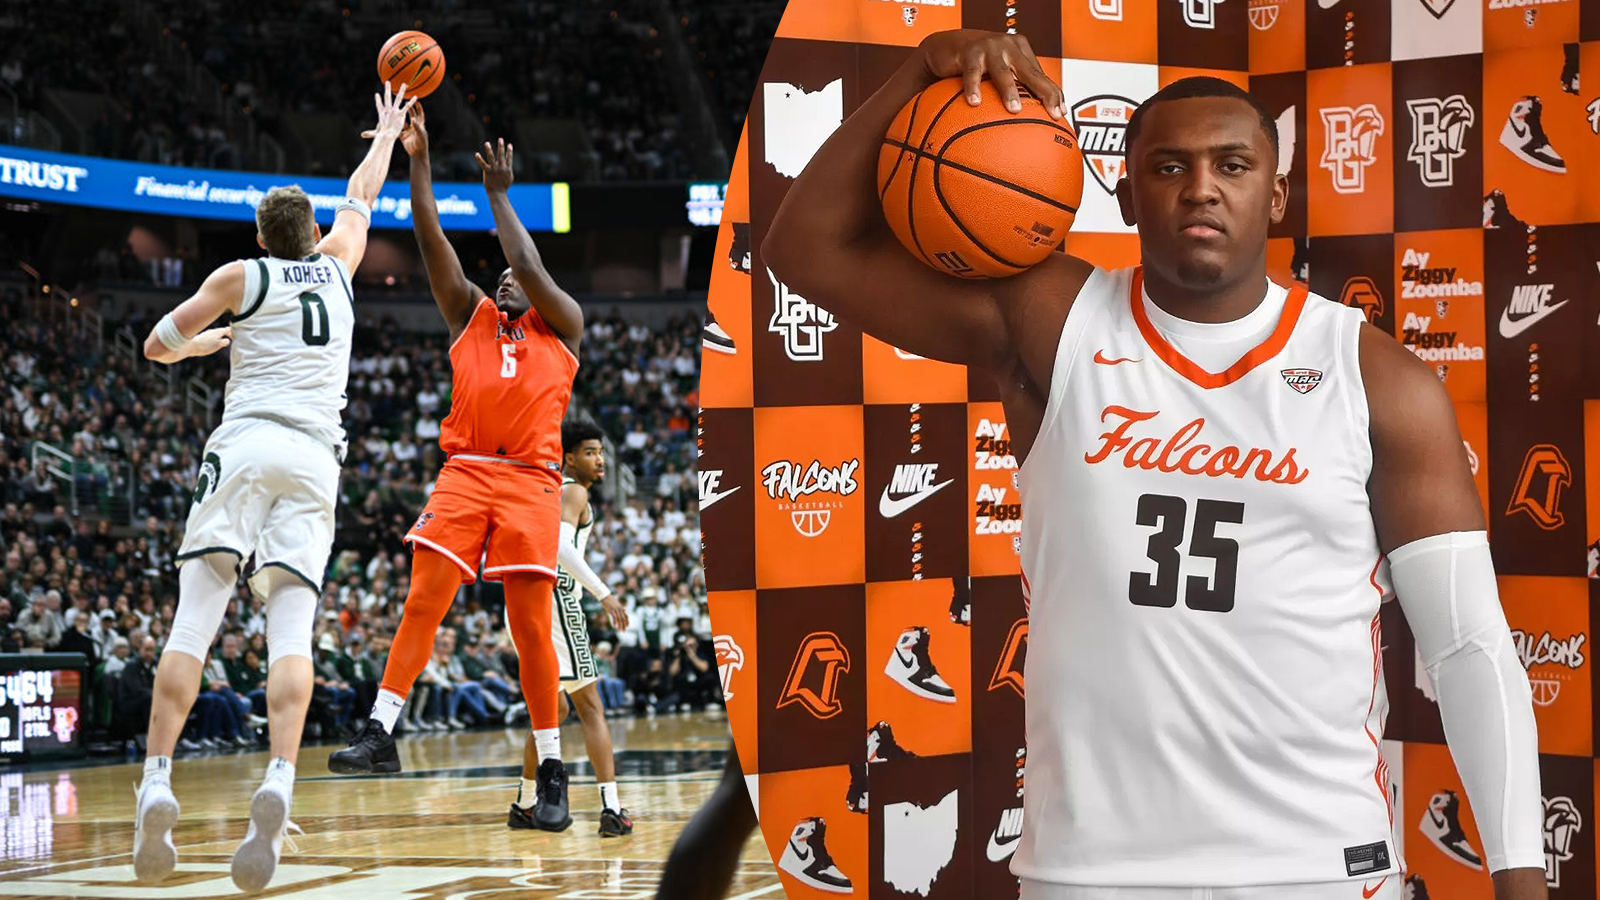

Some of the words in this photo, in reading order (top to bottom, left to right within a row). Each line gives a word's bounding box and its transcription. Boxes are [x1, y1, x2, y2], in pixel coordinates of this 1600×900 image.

[1078, 126, 1126, 151] MA
[1401, 249, 1430, 269] Ay
[282, 265, 334, 284] KOHLER
[1402, 265, 1457, 285] Ziggy
[1401, 278, 1483, 298] Zoomba
[1508, 284, 1554, 314] NIKE
[298, 291, 330, 347] 0
[1402, 312, 1431, 333] Ay
[1402, 329, 1457, 349] Ziggy
[500, 343, 517, 378] 6
[1286, 375, 1321, 384] MAC
[975, 418, 1007, 441] Ay
[976, 436, 1012, 456] Zig
[1084, 404, 1309, 485] Falcons
[975, 451, 1019, 470] Zoo
[698, 470, 724, 498] KE
[761, 458, 860, 502] FALCONS
[889, 463, 939, 494] NIKE
[976, 483, 1007, 505] Ay
[778, 501, 844, 511] BASKETBALL
[976, 501, 1022, 520] Zigg
[975, 516, 1022, 535] Zoo
[1128, 493, 1245, 613] 35
[1510, 629, 1586, 671] ALCONS
[22, 670, 54, 704] 64
[996, 807, 1024, 838] NI
